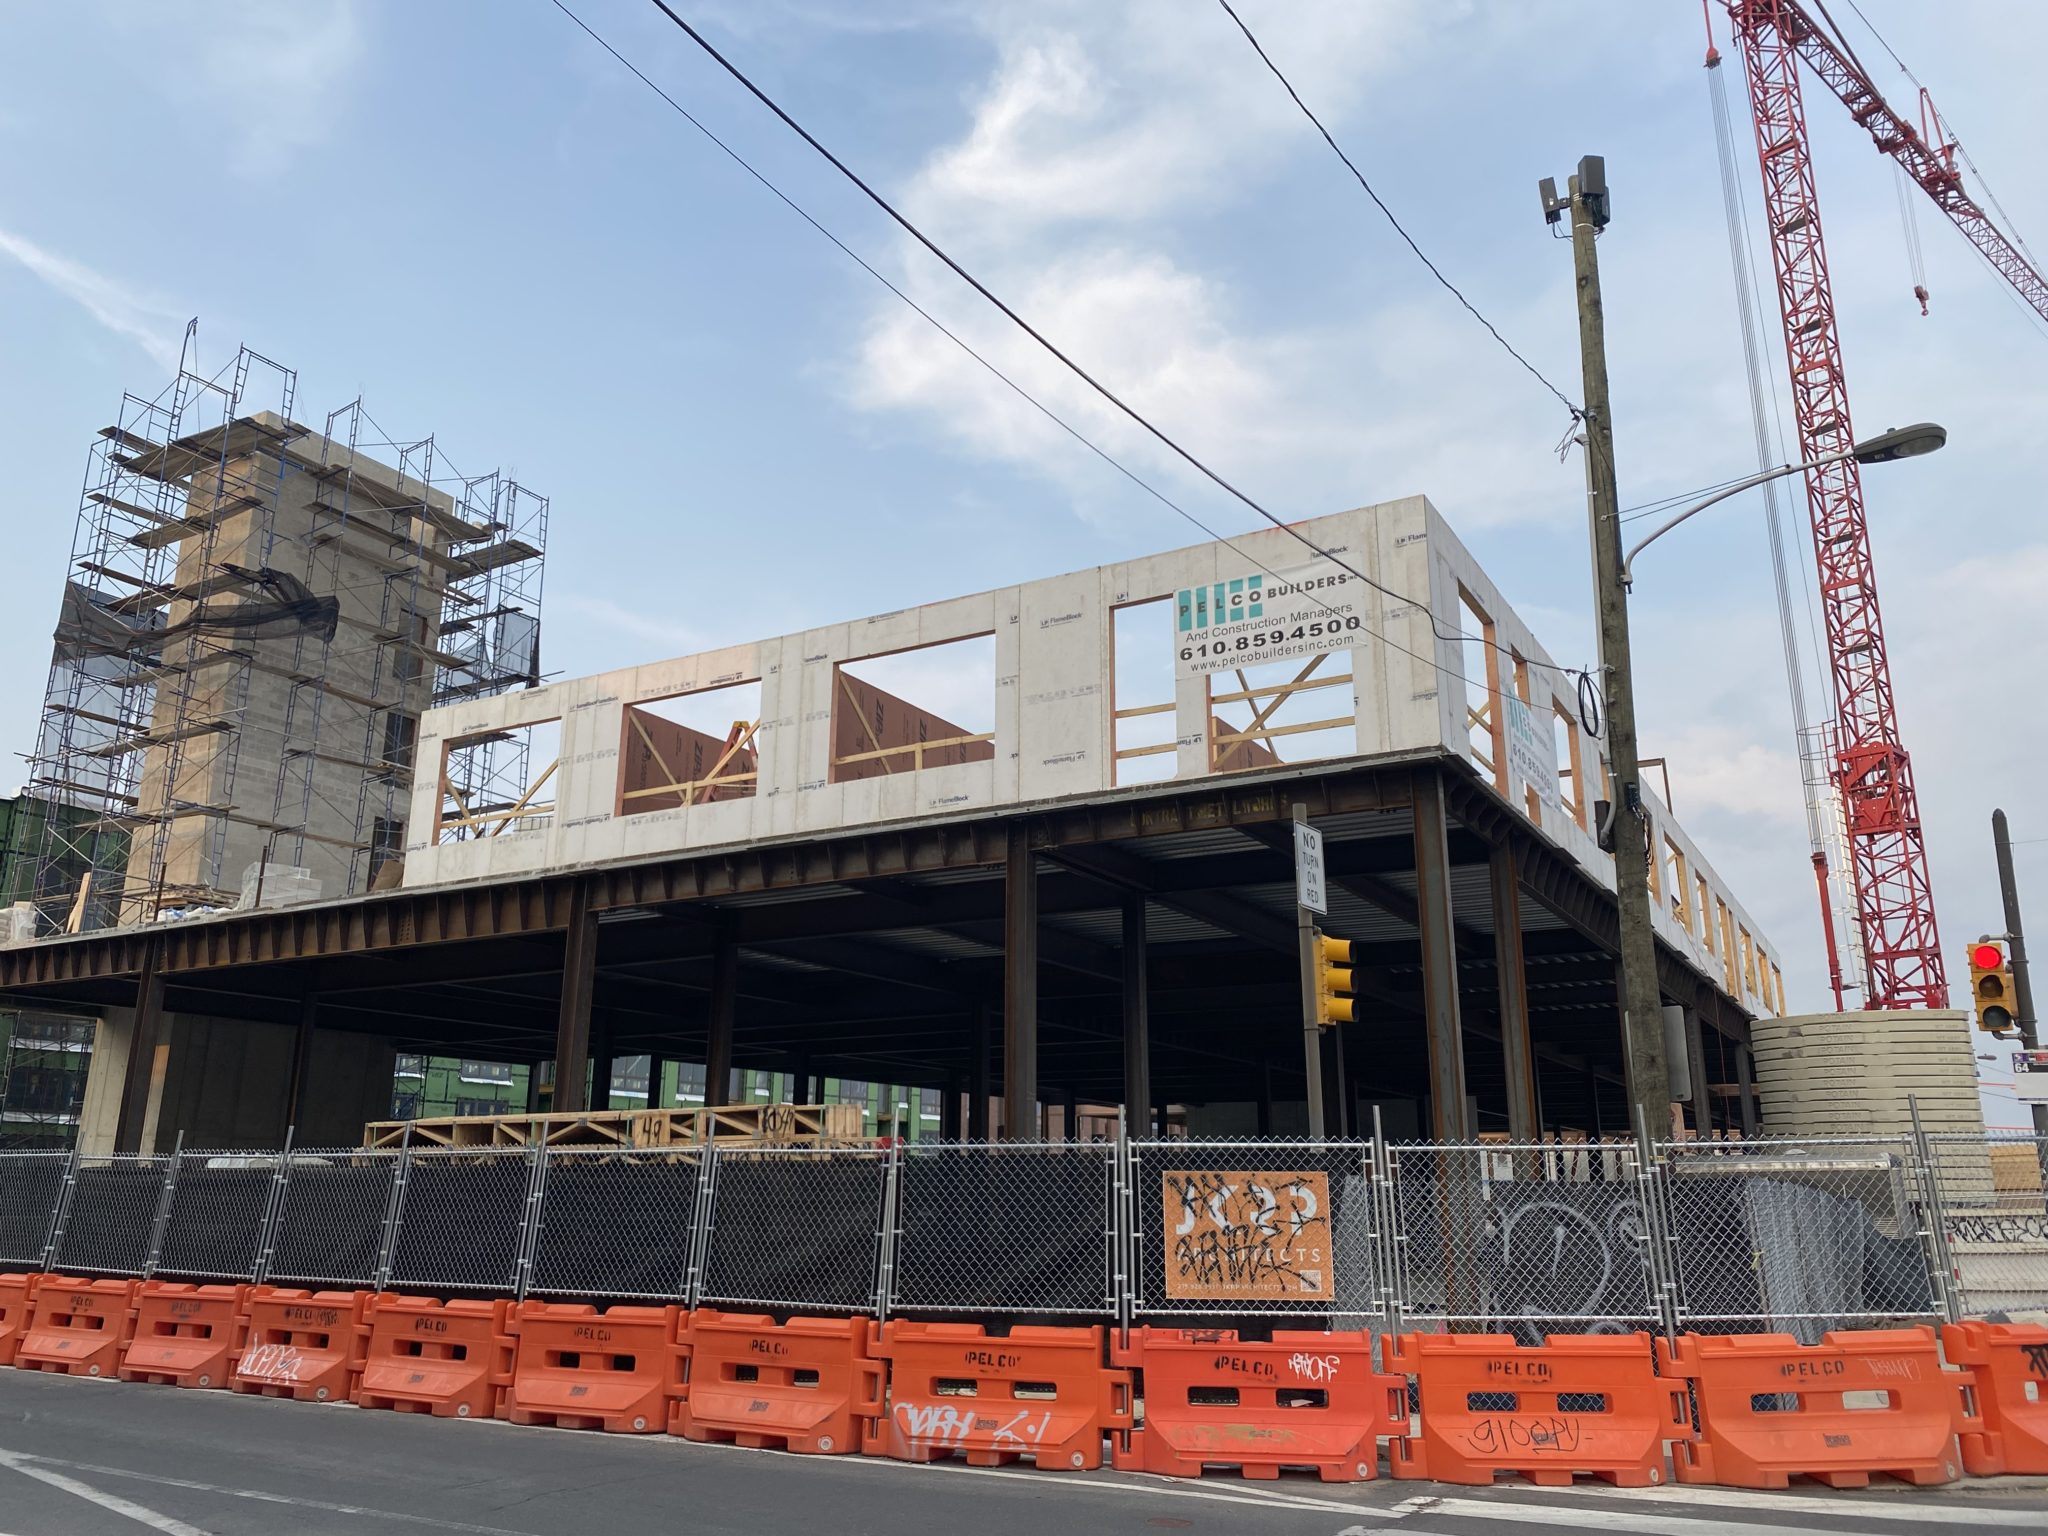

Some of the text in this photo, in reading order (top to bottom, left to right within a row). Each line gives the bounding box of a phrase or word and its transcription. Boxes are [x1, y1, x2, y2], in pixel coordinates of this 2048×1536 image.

[1180, 590, 1262, 617] PELCO
[1267, 574, 1348, 599] BUILDERS
[1185, 603, 1353, 642] And Construction Managers
[1180, 616, 1361, 661] 610.859.4500
[1190, 634, 1355, 671] www.pelcobuildersinc.com
[1302, 832, 1316, 850] NO
[1302, 851, 1319, 869] TURN
[1307, 871, 1317, 885] ON
[1306, 888, 1319, 904] RED
[2014, 1062, 2030, 1073] 64
[1219, 1355, 1274, 1376] PELCO
[1785, 1360, 1845, 1376] PELCO
